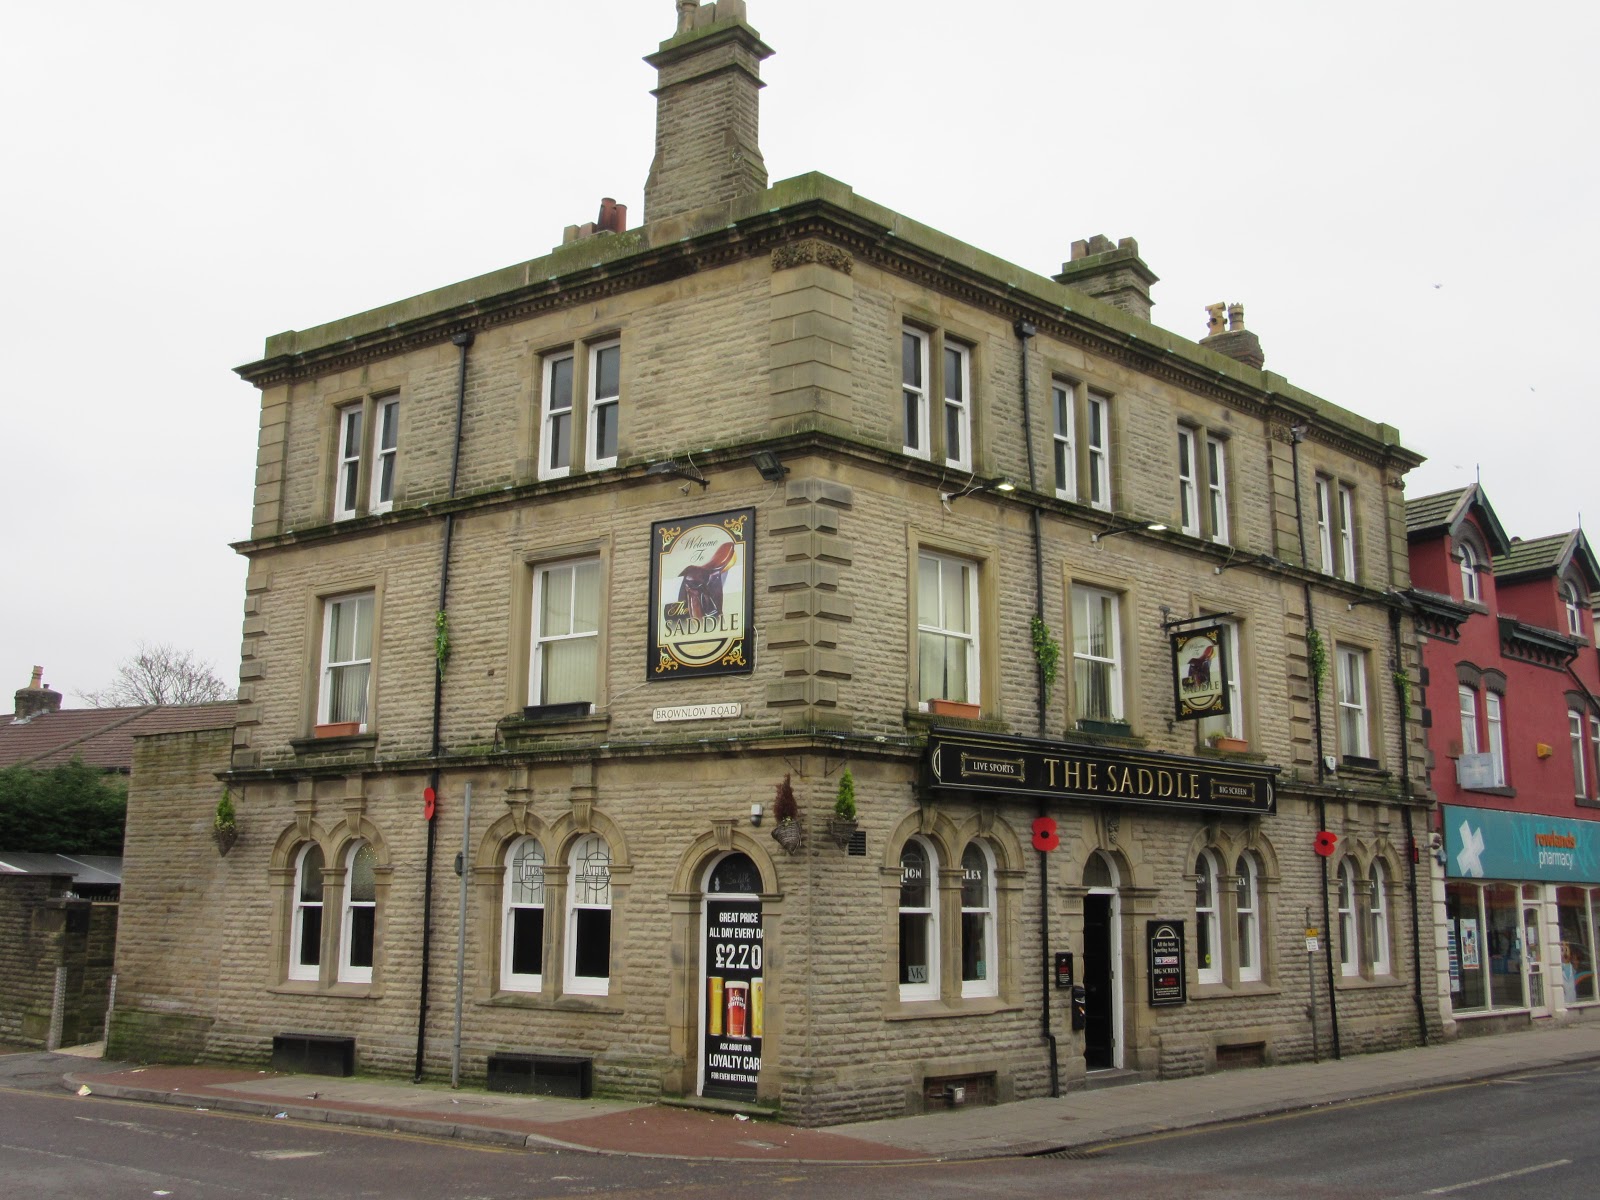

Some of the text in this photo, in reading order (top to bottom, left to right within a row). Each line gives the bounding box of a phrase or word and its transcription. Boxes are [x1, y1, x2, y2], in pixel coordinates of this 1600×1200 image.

[681, 535, 718, 550] Welcome
[690, 548, 706, 563] To
[668, 600, 689, 616] The
[664, 613, 739, 638] SADDLE
[656, 705, 738, 719] BROWNLOW ROAD
[973, 761, 1015, 774] LIVE SPORTS
[1043, 758, 1200, 799] THE SADDLE
[1218, 785, 1248, 796] BIG SCREEN
[1535, 829, 1577, 850] rowlands
[1538, 847, 1574, 871] pharmacy
[719, 912, 759, 924] GREAT PRICE
[709, 927, 764, 939] ALL DAY EVERY DA
[910, 967, 924, 979] VK
[720, 1042, 752, 1052] ASK ABOUT OUR
[709, 1053, 762, 1071] LOYALTY CAR
[711, 1072, 758, 1083] FOR EVEN BETTER VALU
